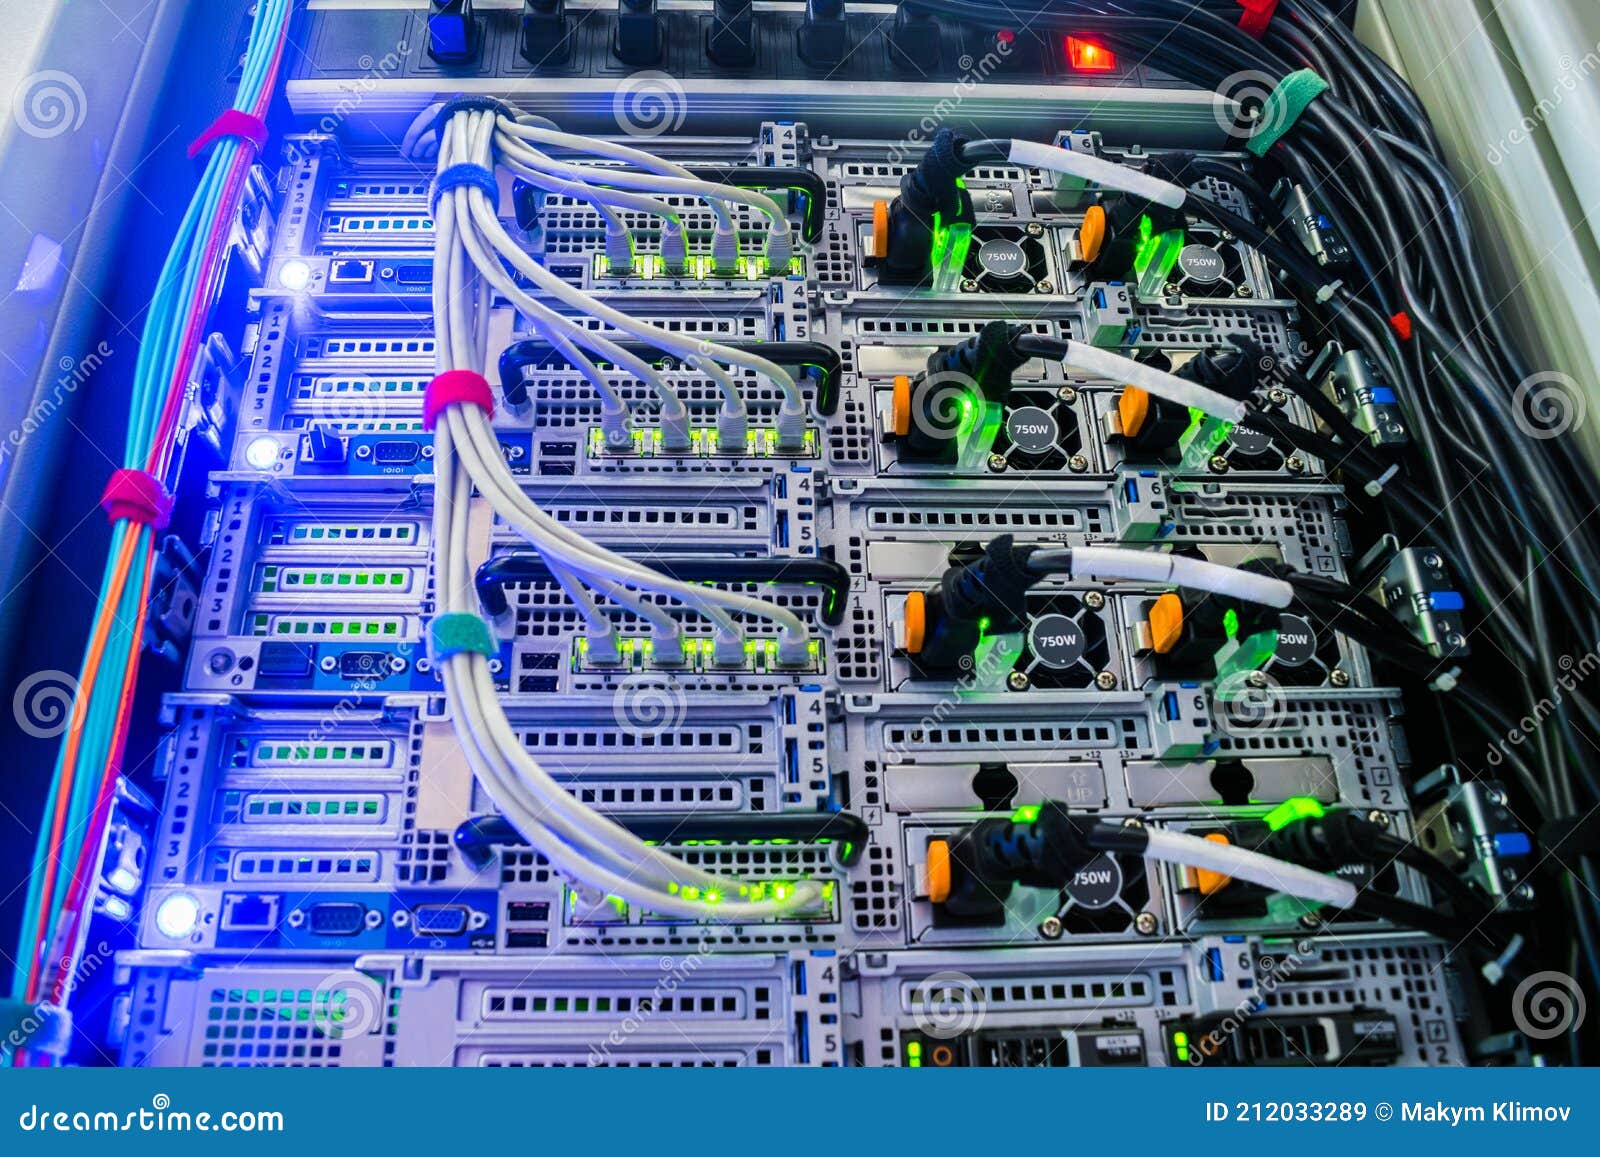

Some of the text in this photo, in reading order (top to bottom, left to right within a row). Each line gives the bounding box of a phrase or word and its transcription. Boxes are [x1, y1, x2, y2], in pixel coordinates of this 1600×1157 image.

[783, 129, 793, 140] 4
[1082, 138, 1091, 149] 6
[303, 158, 312, 169] 1
[296, 192, 305, 202] 2
[828, 222, 837, 232] 1
[986, 252, 1018, 262] 750W
[1186, 258, 1217, 267] 750W
[793, 285, 805, 297] 4
[1118, 291, 1127, 302] 6
[271, 315, 281, 327] 1
[796, 326, 806, 338] 5
[262, 356, 273, 368] 2
[845, 390, 854, 401] 1
[254, 398, 264, 409] 3
[1014, 424, 1049, 434] 750W
[798, 478, 810, 491] 4
[1150, 482, 1161, 495] 6
[232, 503, 242, 515] 1
[801, 526, 811, 540] 5
[221, 550, 232, 562] 2
[211, 599, 222, 613] 3
[853, 595, 863, 609] 1
[1039, 634, 1077, 647] 750W
[809, 699, 822, 715] 4
[1193, 695, 1205, 710] 6
[189, 725, 199, 741] 1
[812, 757, 824, 773] 5
[177, 782, 190, 798] 2
[1381, 789, 1393, 804] 2
[869, 829, 878, 845] 1
[167, 840, 180, 857] 3
[1238, 952, 1250, 970] 6
[822, 966, 834, 984] 4
[146, 984, 156, 1004] 1
[825, 1034, 836, 1053] 5
[1436, 1046, 1449, 1063] 2
